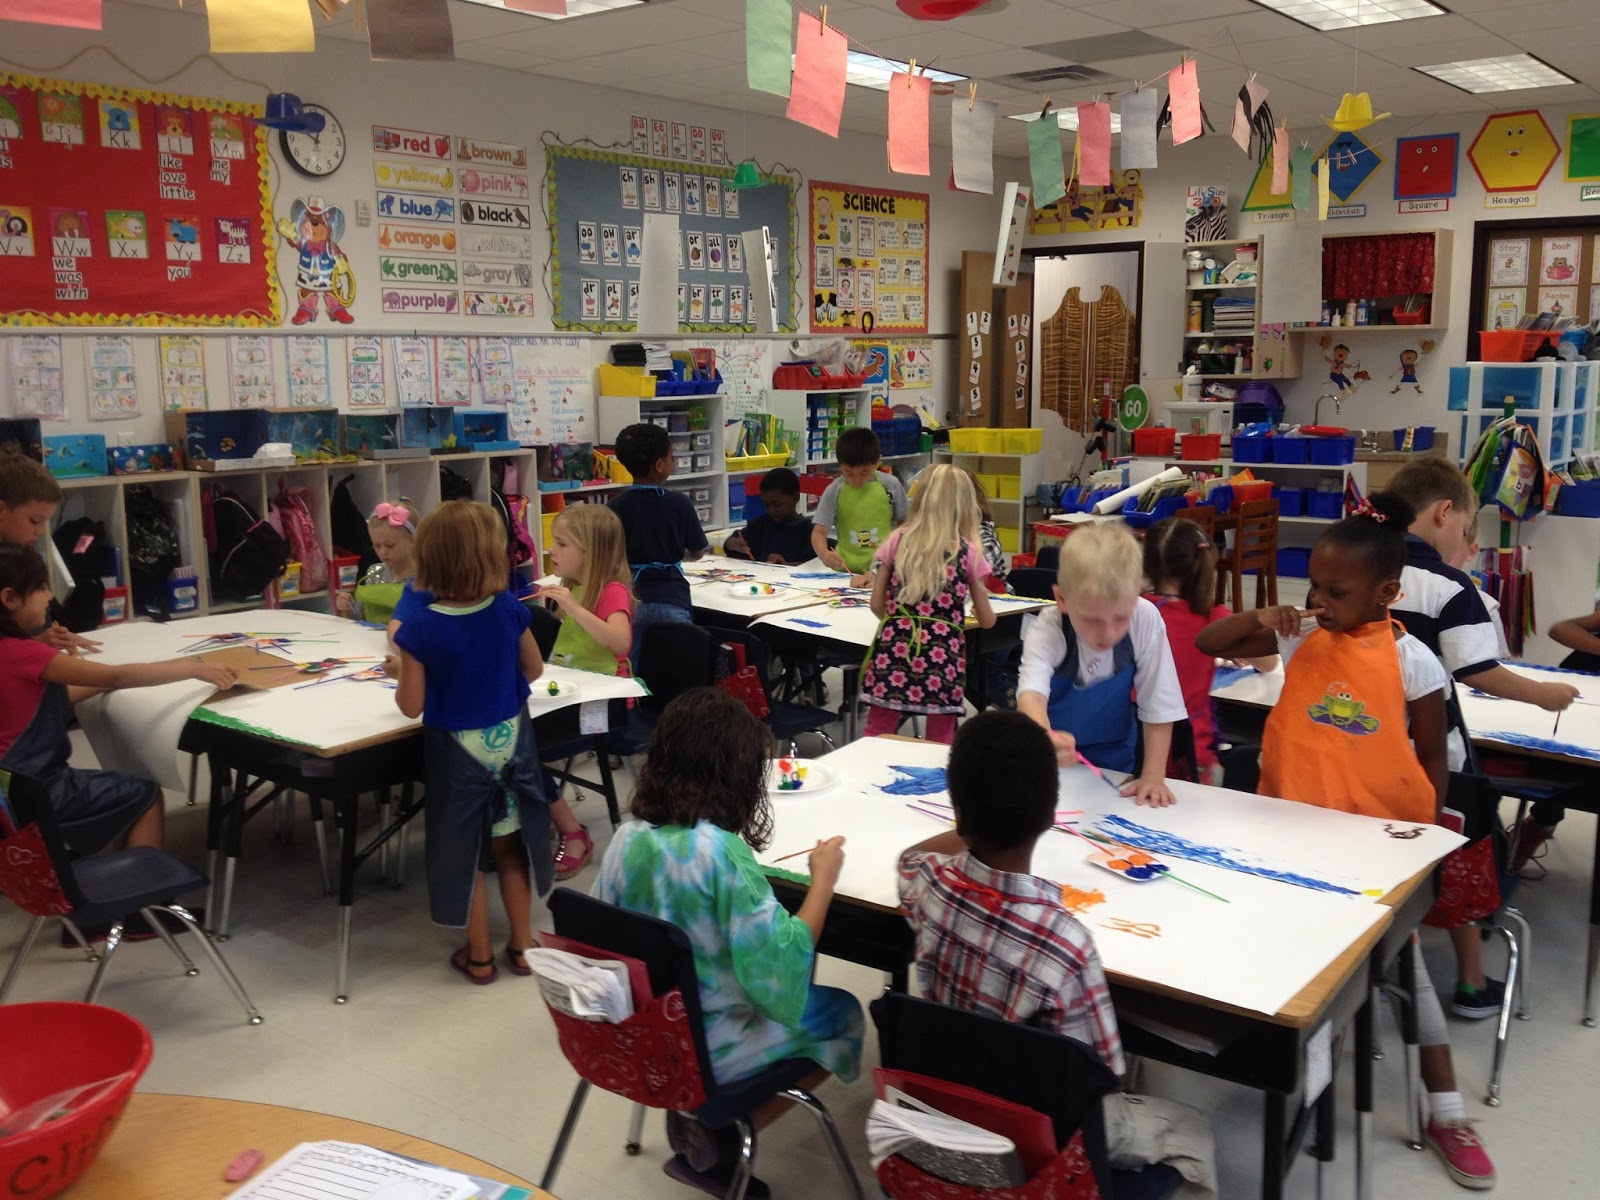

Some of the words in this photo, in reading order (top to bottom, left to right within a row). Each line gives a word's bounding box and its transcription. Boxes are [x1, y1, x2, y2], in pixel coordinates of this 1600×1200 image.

[331, 124, 337, 133] 2
[55, 124, 72, 150] Jj
[108, 130, 131, 149] Kk
[289, 134, 295, 143] 9
[336, 137, 342, 147] 3
[212, 142, 242, 158] Mm
[403, 136, 430, 153] red
[293, 147, 300, 157] 8
[334, 151, 339, 159] 4
[471, 143, 512, 162] brown
[159, 154, 182, 168] like
[212, 160, 229, 169] me
[304, 158, 310, 168] 7
[327, 160, 332, 169] 5
[316, 163, 322, 172] 6
[160, 171, 185, 183] love
[211, 171, 229, 183] my
[393, 164, 440, 184] yellow
[622, 173, 634, 183] ch
[644, 174, 655, 185] sh
[481, 176, 513, 192] pink
[665, 177, 677, 188] th
[686, 179, 698, 190] wh
[706, 181, 717, 193] ph
[161, 184, 194, 199] little
[1187, 186, 1206, 197] Life
[1207, 186, 1227, 198] Size
[843, 192, 896, 214] SCIENCE
[1408, 202, 1439, 210] Square
[1491, 195, 1530, 206] Hexagon
[400, 199, 433, 216] blue
[478, 205, 514, 222] black
[1257, 210, 1290, 220] Triangle
[581, 227, 593, 238] oo
[626, 231, 637, 240] ar
[394, 231, 440, 249] orange
[480, 237, 518, 252] white
[689, 235, 699, 245] or
[708, 237, 720, 247] all
[729, 239, 739, 249] oy
[54, 239, 88, 256] Ww
[117, 240, 139, 257] Xx
[1498, 243, 1522, 253] Story
[1551, 242, 1571, 250] Book
[173, 244, 193, 266] Yy
[226, 246, 244, 262] Zz
[54, 258, 74, 268] we
[168, 268, 191, 281] you
[397, 261, 439, 277] green
[56, 273, 82, 283] was
[483, 268, 512, 284] gray
[56, 285, 87, 299] with
[583, 282, 596, 294] dr
[607, 284, 617, 297] pl
[692, 288, 702, 298] br
[711, 289, 721, 298] tr
[731, 290, 741, 300] st
[1498, 293, 1515, 301] List
[1544, 292, 1571, 301] Recipe
[401, 293, 447, 310] purple
[1125, 400, 1142, 417] GO
